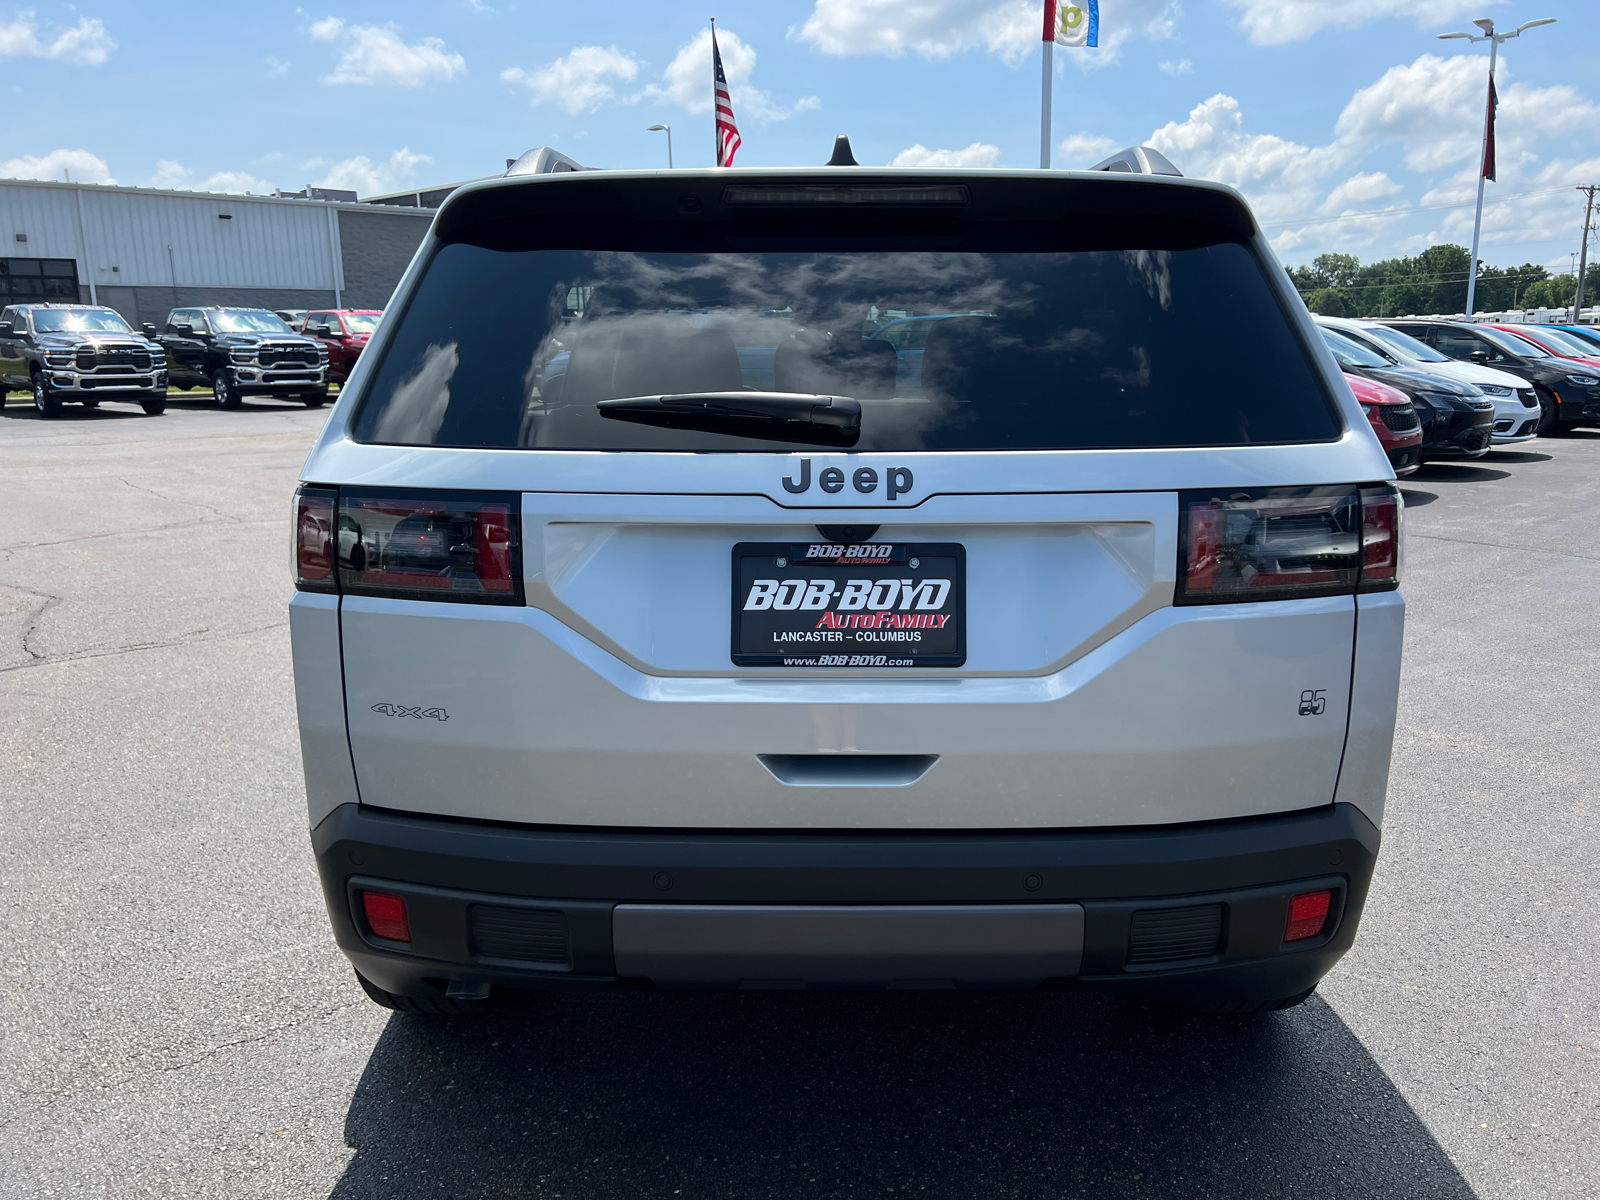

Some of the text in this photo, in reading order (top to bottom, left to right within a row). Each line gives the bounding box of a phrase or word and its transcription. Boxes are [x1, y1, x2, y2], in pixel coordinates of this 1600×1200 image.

[781, 458, 914, 501] Jeep
[805, 544, 893, 558] BOB-BOYD
[742, 579, 952, 611] BOB-BOYD
[773, 631, 843, 642] LANCASTER
[855, 631, 922, 642] COLUMBUS
[783, 655, 914, 666] www.BOB-BOYD.com
[1298, 689, 1327, 717] 85
